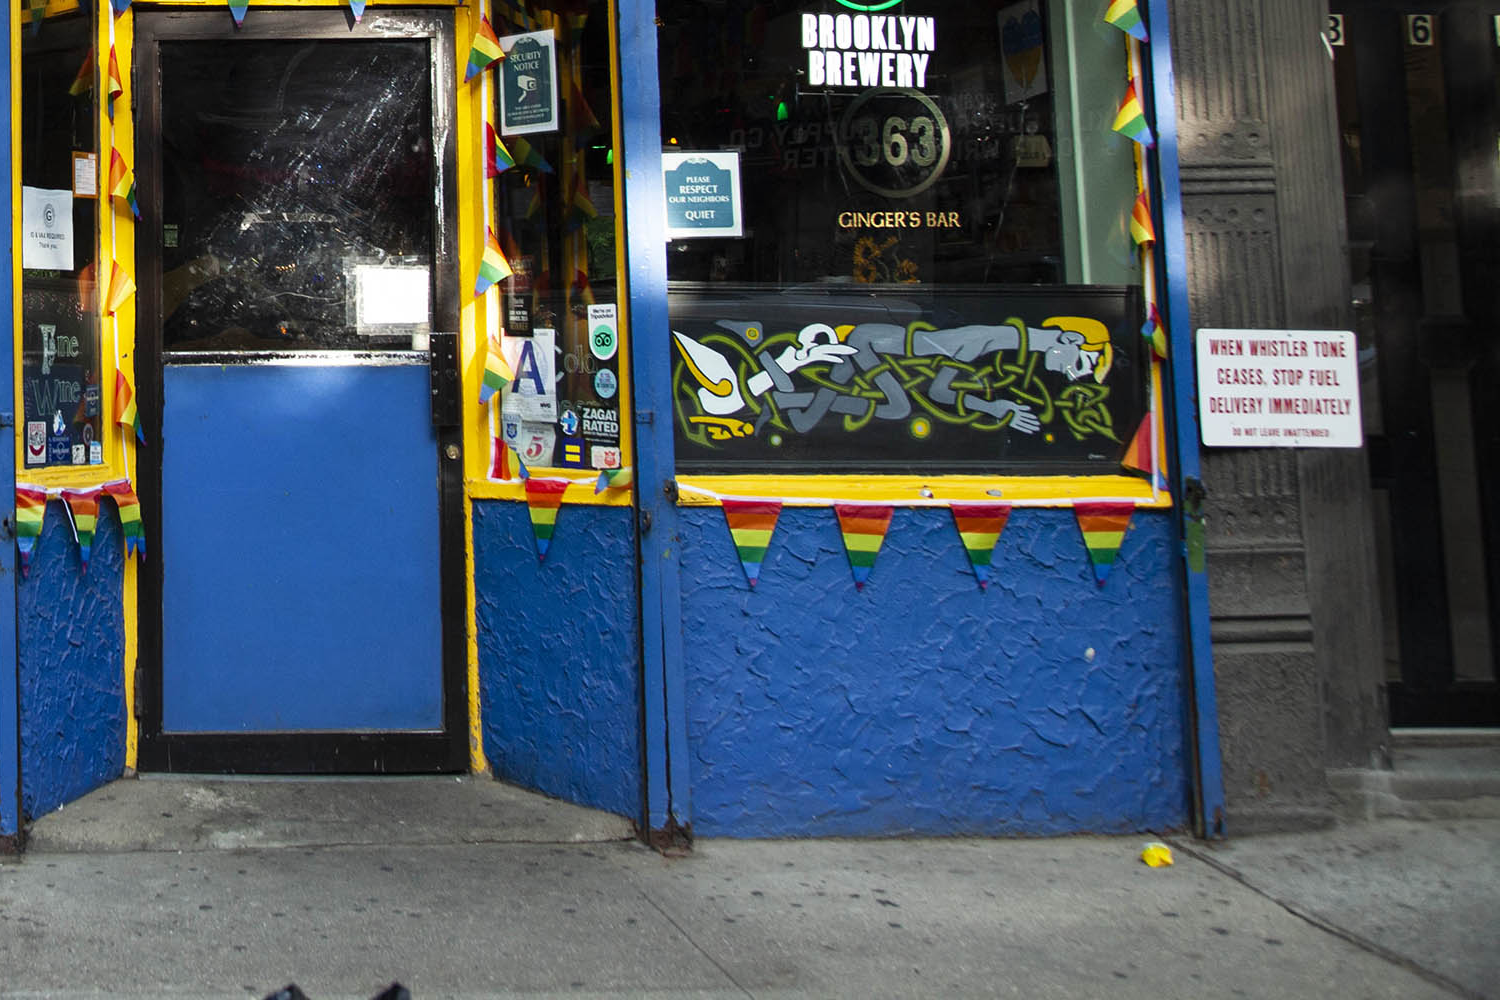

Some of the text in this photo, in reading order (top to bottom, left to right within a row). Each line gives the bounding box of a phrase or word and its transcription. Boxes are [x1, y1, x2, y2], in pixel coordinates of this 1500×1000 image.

[801, 13, 935, 51] BROOKLYN
[1412, 16, 1429, 43] 6
[509, 50, 542, 63] SECURITY
[513, 60, 540, 73] NOTICE
[808, 50, 930, 88] BREWERY
[854, 115, 936, 168] 363
[686, 176, 711, 184] PLEASE
[679, 184, 718, 194] RESPECT
[668, 195, 731, 204] OUR NEIGHBORS
[685, 210, 716, 221] QUIET
[838, 211, 962, 228] GINGER'S BAR
[1209, 339, 1347, 358] WHEN WHISTLER TONE
[511, 340, 546, 395] A
[1273, 369, 1303, 386] STOP
[1309, 369, 1340, 386] FUEL
[1209, 397, 1352, 415] DELIVERY IMMEDIATELY
[583, 420, 619, 433] RATED
[1232, 427, 1330, 438] DO NOT LEAVE UNATTENDED
